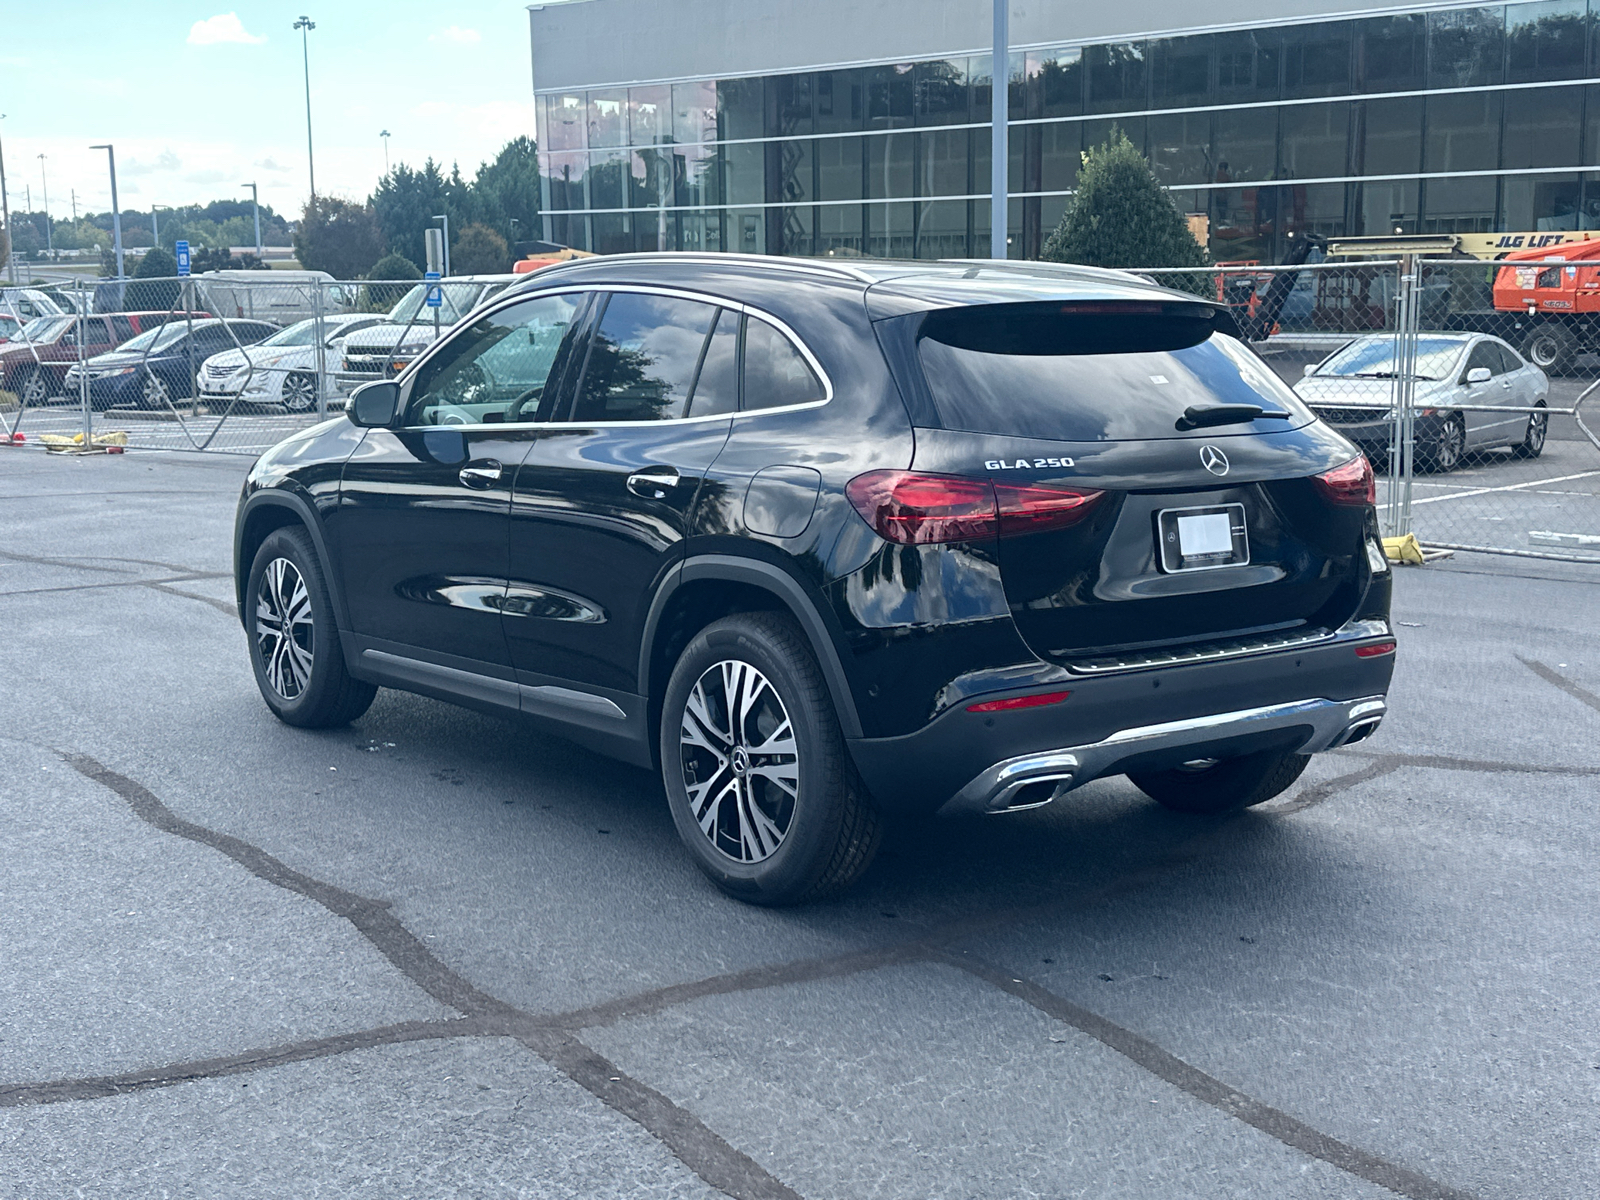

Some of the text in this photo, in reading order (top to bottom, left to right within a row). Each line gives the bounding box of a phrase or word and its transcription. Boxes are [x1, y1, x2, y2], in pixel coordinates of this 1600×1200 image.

[1495, 235, 1564, 248] JLG LIFT
[984, 457, 1075, 470] GLA 250
